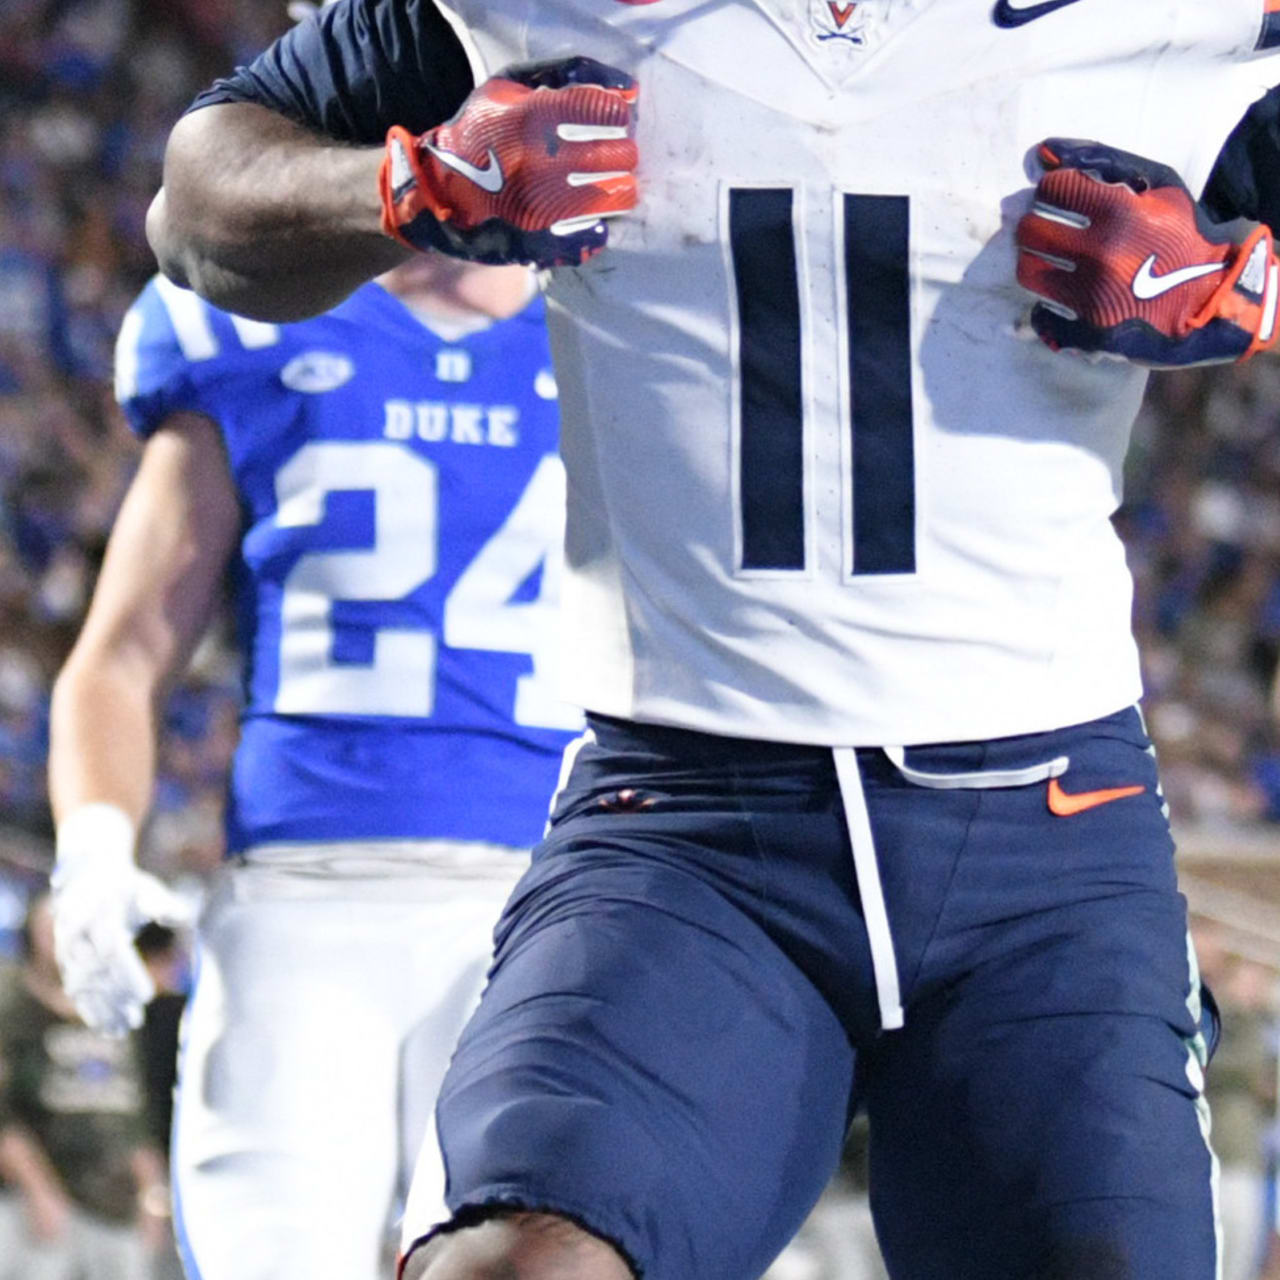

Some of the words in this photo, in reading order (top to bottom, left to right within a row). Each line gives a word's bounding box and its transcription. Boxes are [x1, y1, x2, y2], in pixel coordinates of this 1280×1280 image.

[384, 399, 518, 448] DUKE
[725, 185, 919, 578] 11
[273, 439, 587, 731] 24
